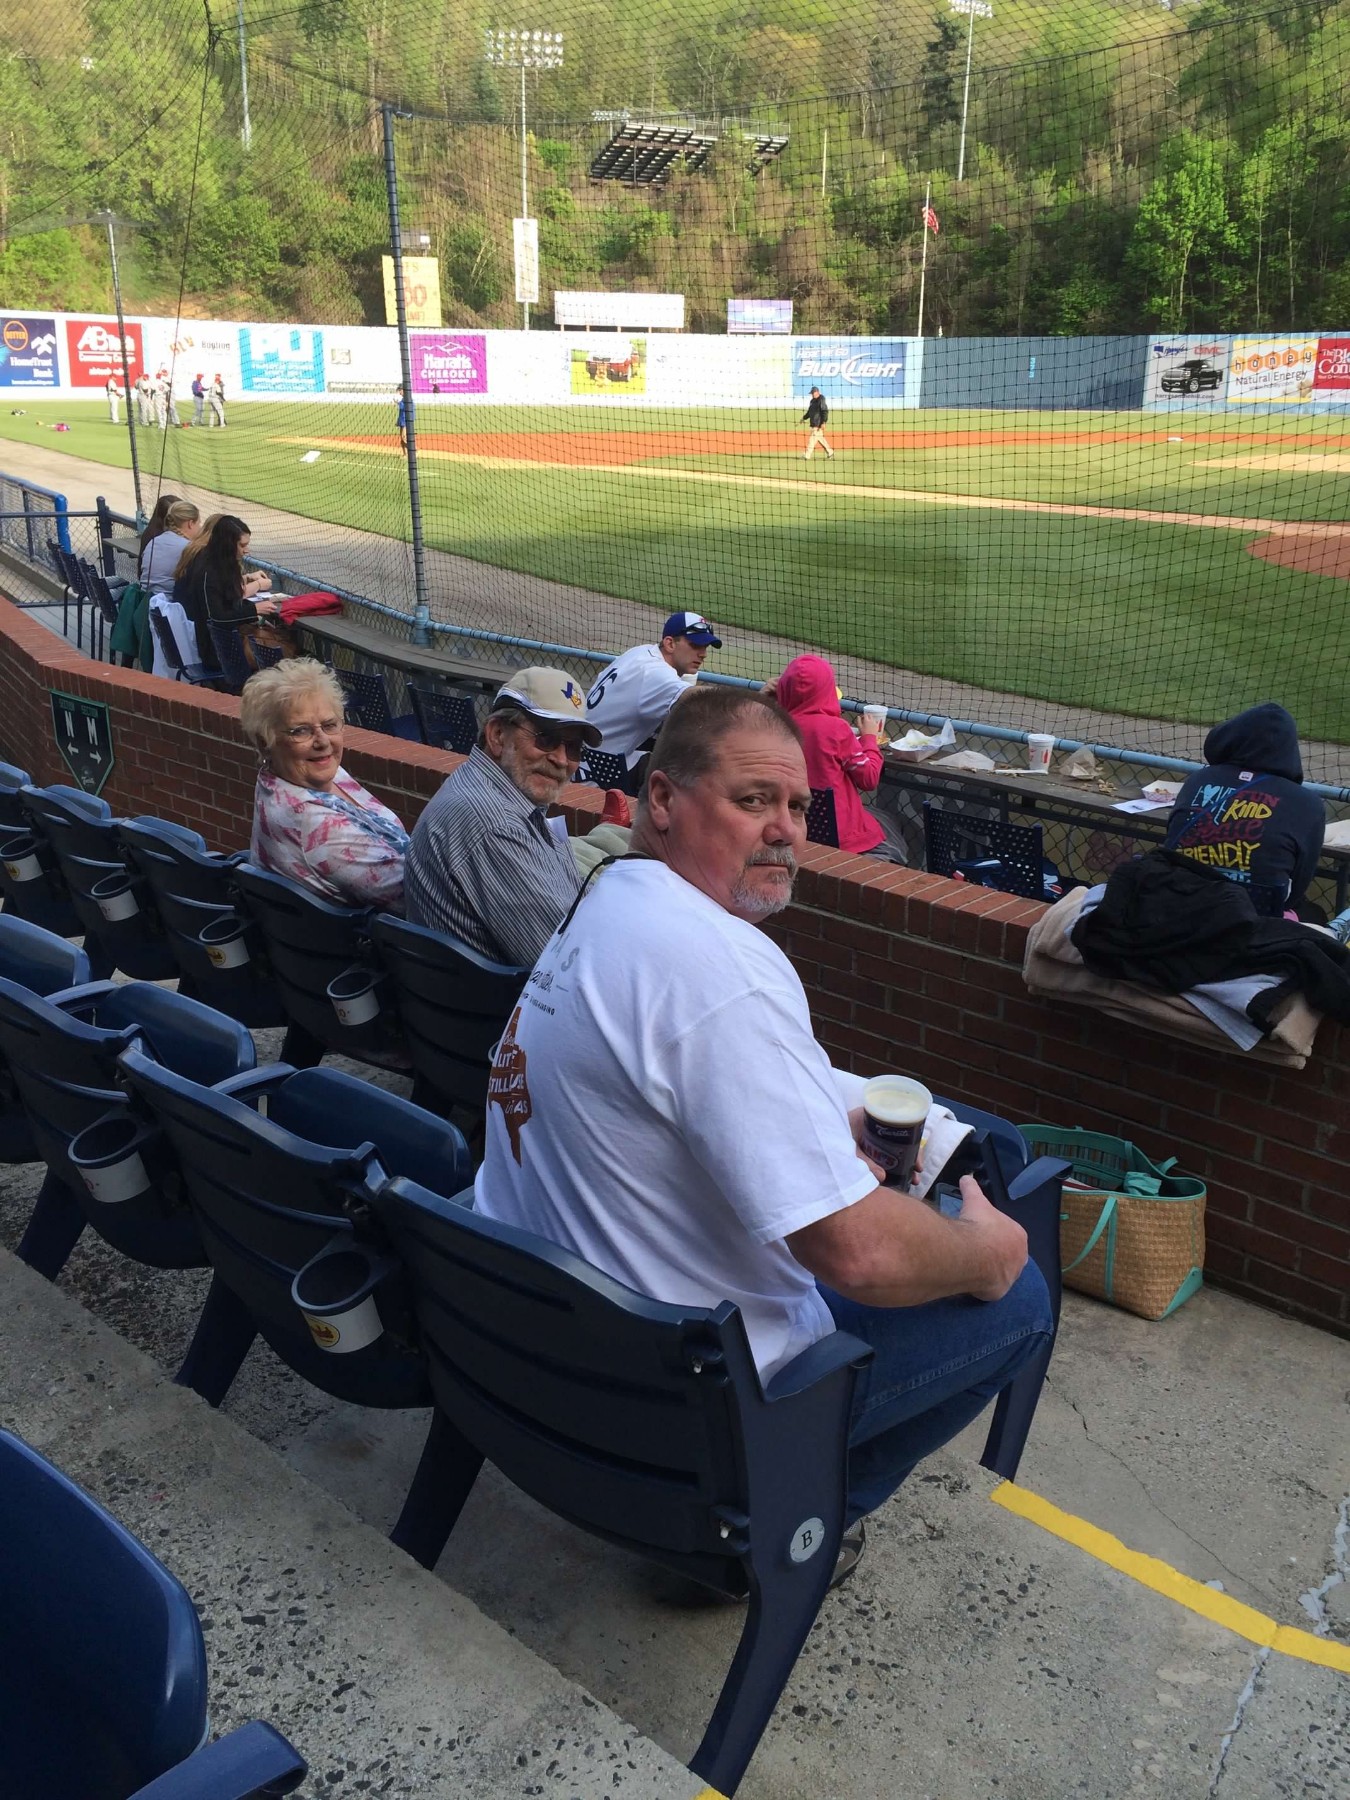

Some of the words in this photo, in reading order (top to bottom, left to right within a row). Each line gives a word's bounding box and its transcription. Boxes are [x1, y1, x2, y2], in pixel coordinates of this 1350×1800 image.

[798, 360, 840, 377] BUD
[846, 360, 902, 378] LIGHT
[1235, 351, 1312, 371] honey
[1318, 358, 1350, 375] Con
[421, 369, 477, 379] CHEROKEE
[1235, 373, 1271, 386] Natural
[1273, 370, 1308, 382] Energy
[64, 710, 75, 738] N
[86, 716, 98, 746] M
[1221, 799, 1272, 822] KIND
[802, 1529, 812, 1550] B
